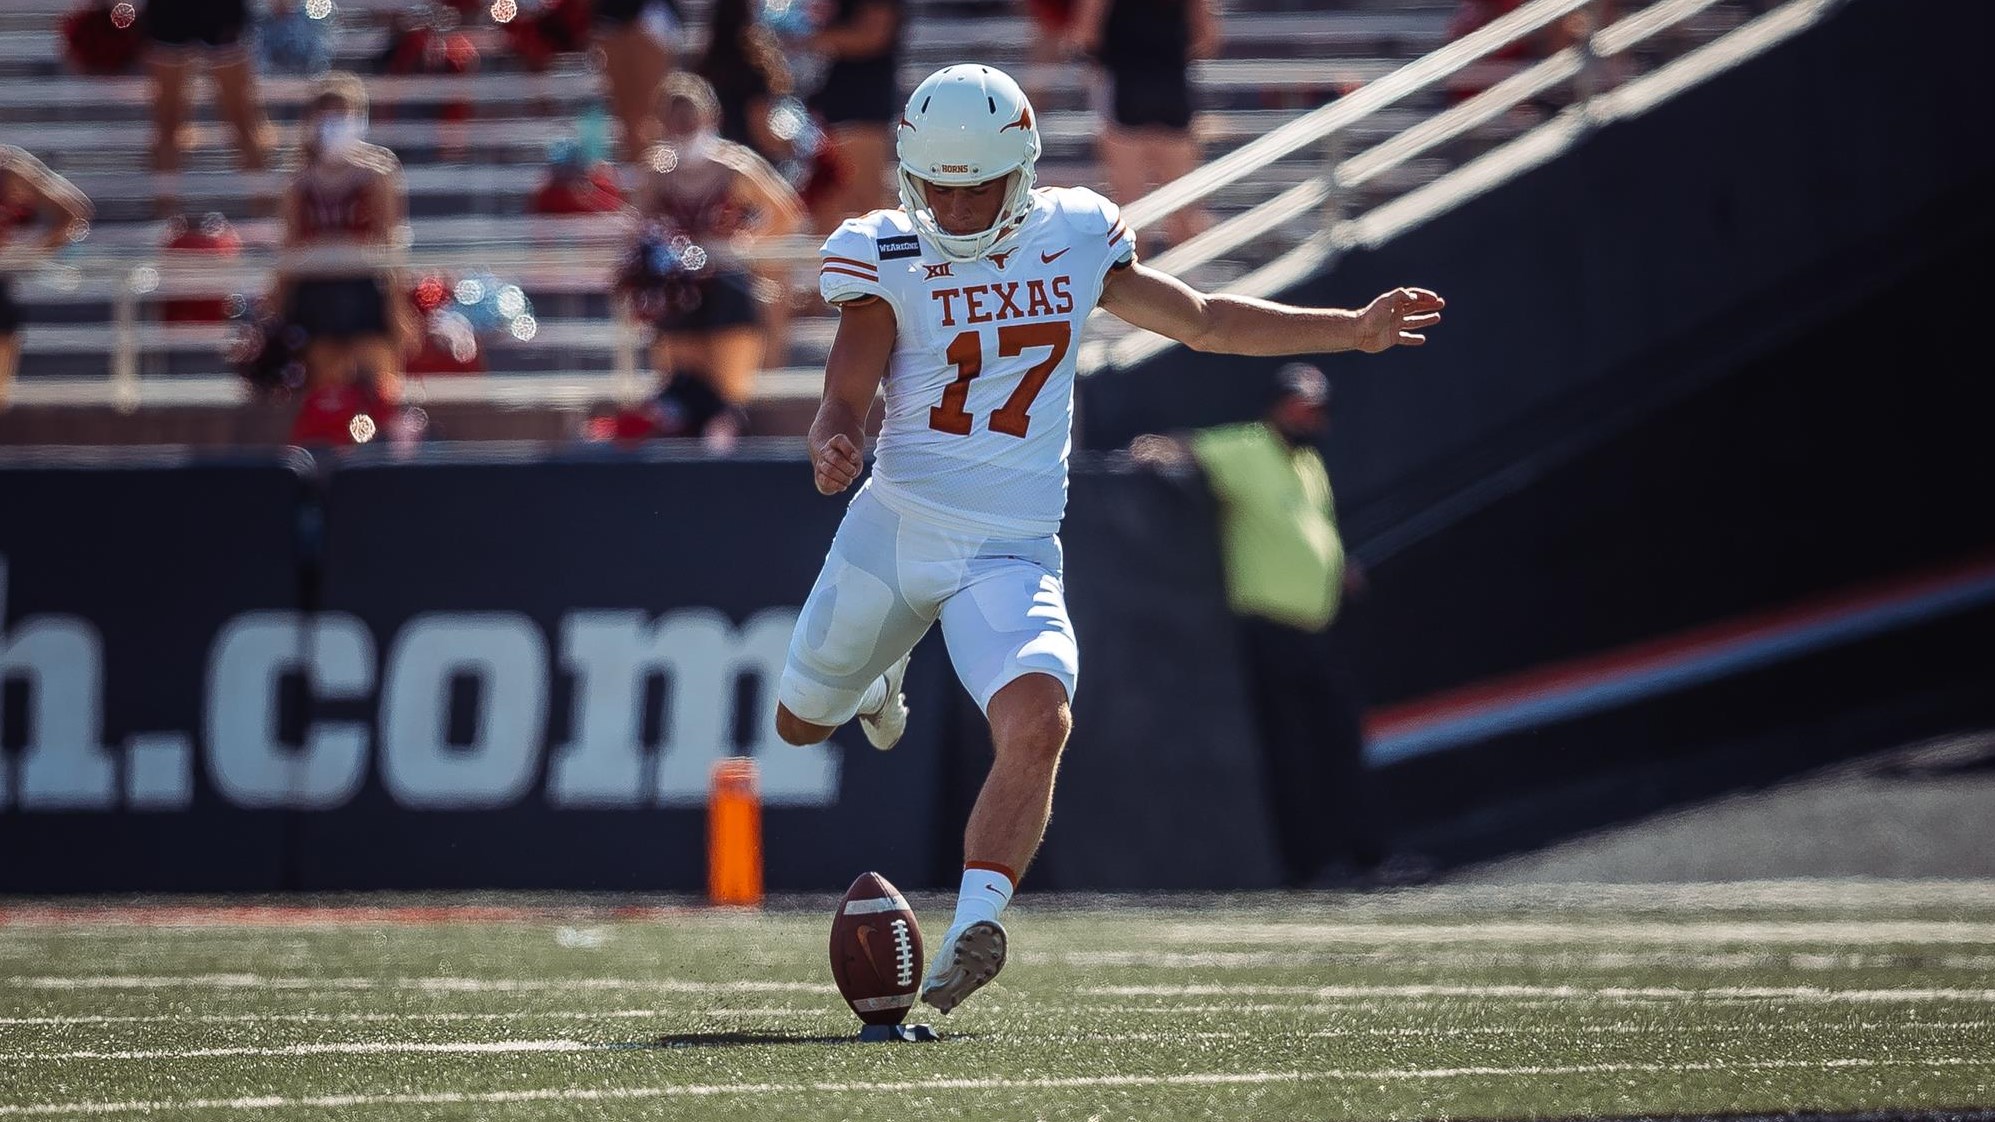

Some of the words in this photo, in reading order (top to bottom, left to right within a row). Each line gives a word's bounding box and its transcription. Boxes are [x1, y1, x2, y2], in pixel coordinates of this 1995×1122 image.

[941, 164, 969, 173] HORNS
[931, 275, 1074, 327] TEXAS
[929, 320, 1072, 438] 17
